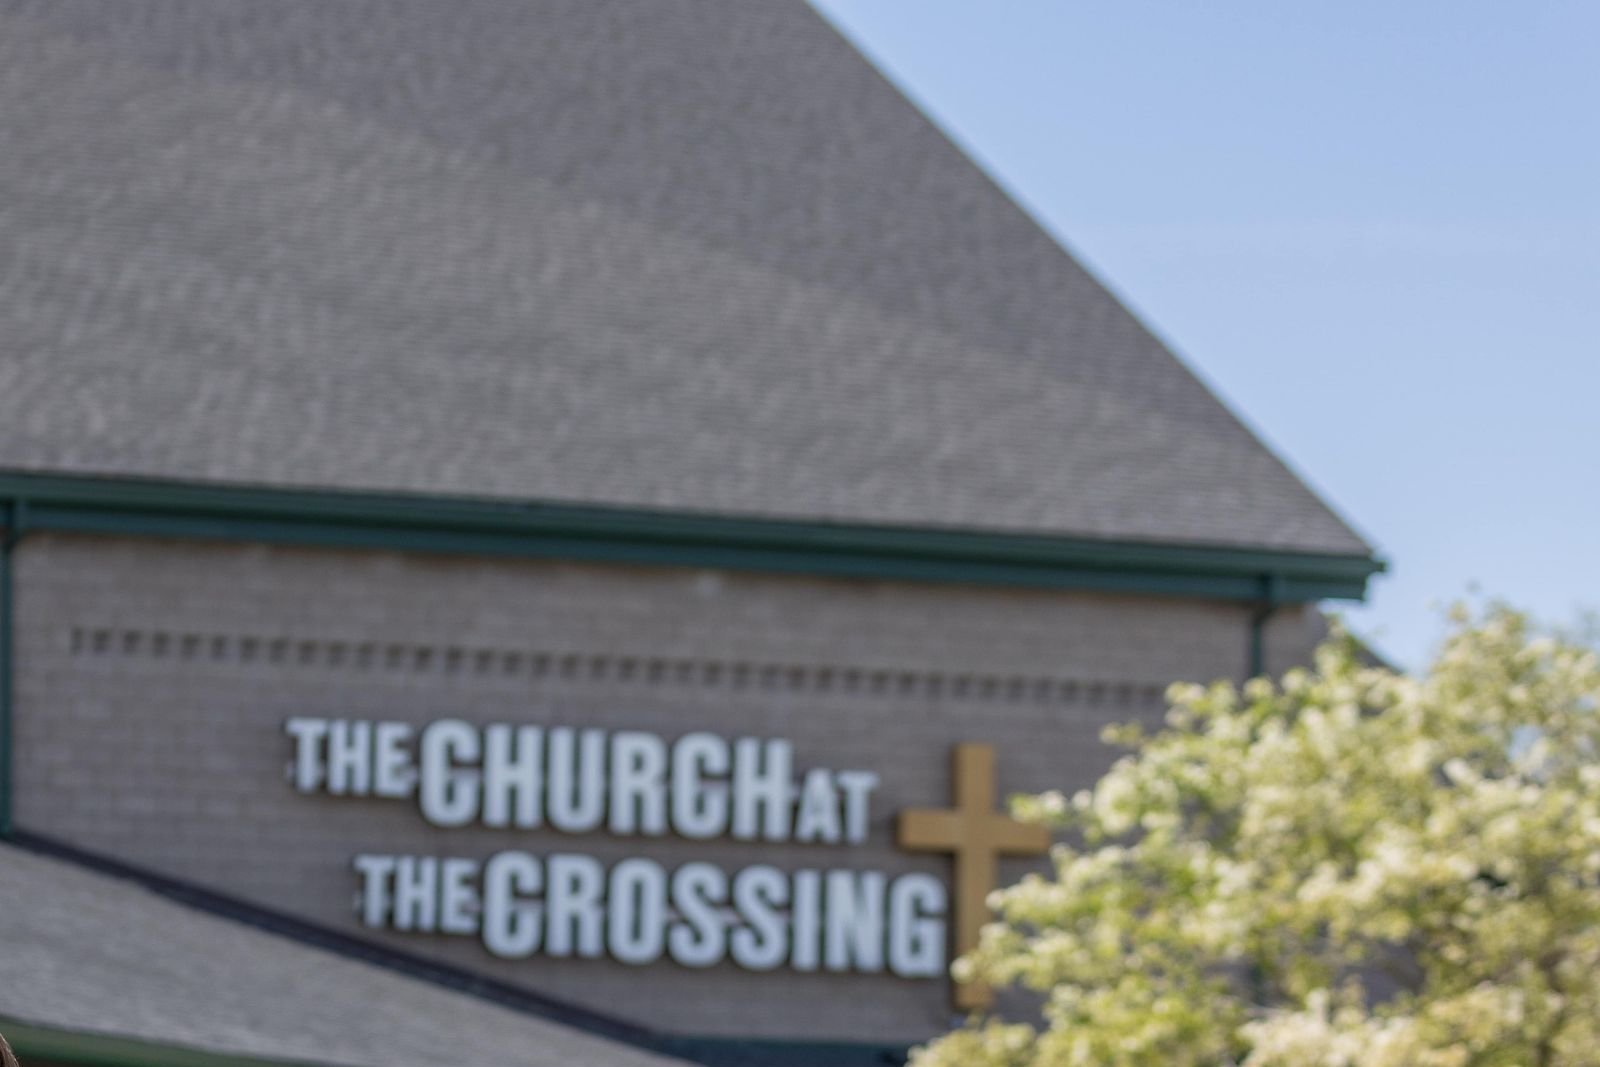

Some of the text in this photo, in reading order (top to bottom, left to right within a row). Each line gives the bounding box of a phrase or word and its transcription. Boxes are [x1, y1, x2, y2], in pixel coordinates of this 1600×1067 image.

[286, 718, 879, 845] THE CHURCH AT
[353, 850, 949, 979] THE CROSSING
